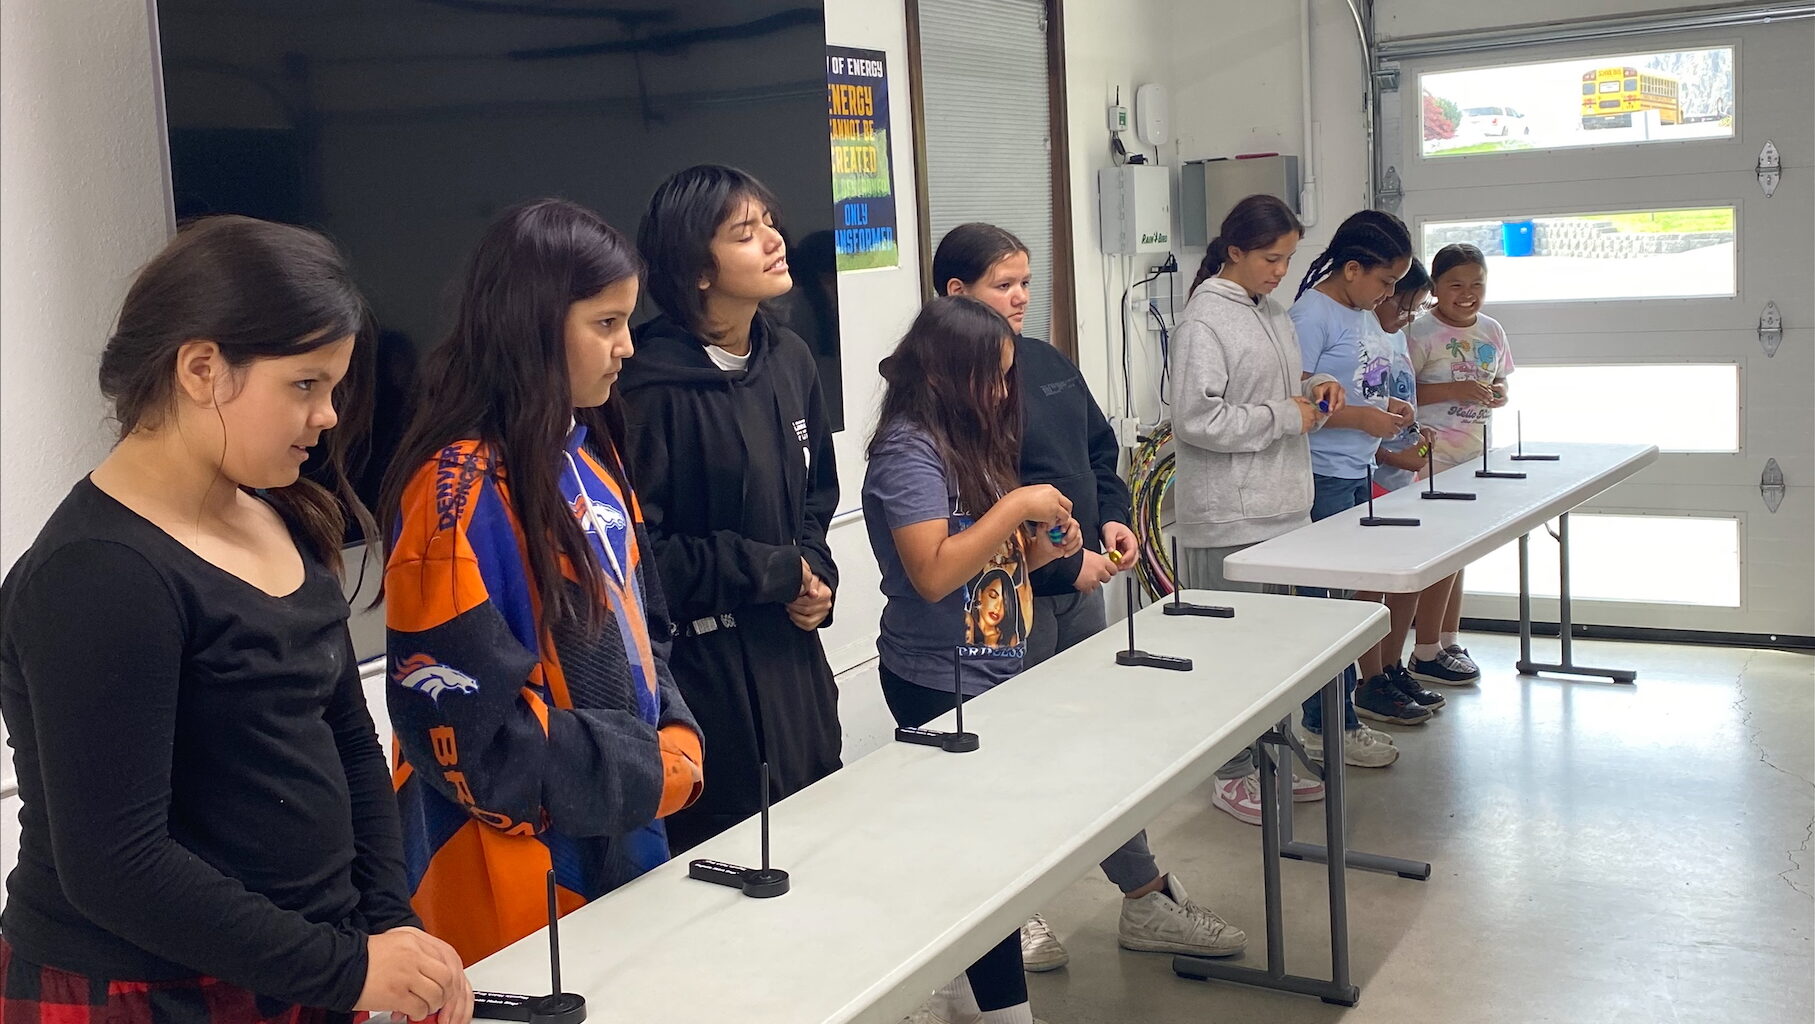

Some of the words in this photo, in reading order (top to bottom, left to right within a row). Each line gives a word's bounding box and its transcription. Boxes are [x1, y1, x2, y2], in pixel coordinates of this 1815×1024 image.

[832, 56, 844, 75] OF
[847, 58, 883, 77] ENERGY
[863, 120, 875, 142] BE
[844, 204, 868, 226] ONLY
[835, 227, 893, 254] ANSFORMED
[436, 446, 463, 531] DENVER
